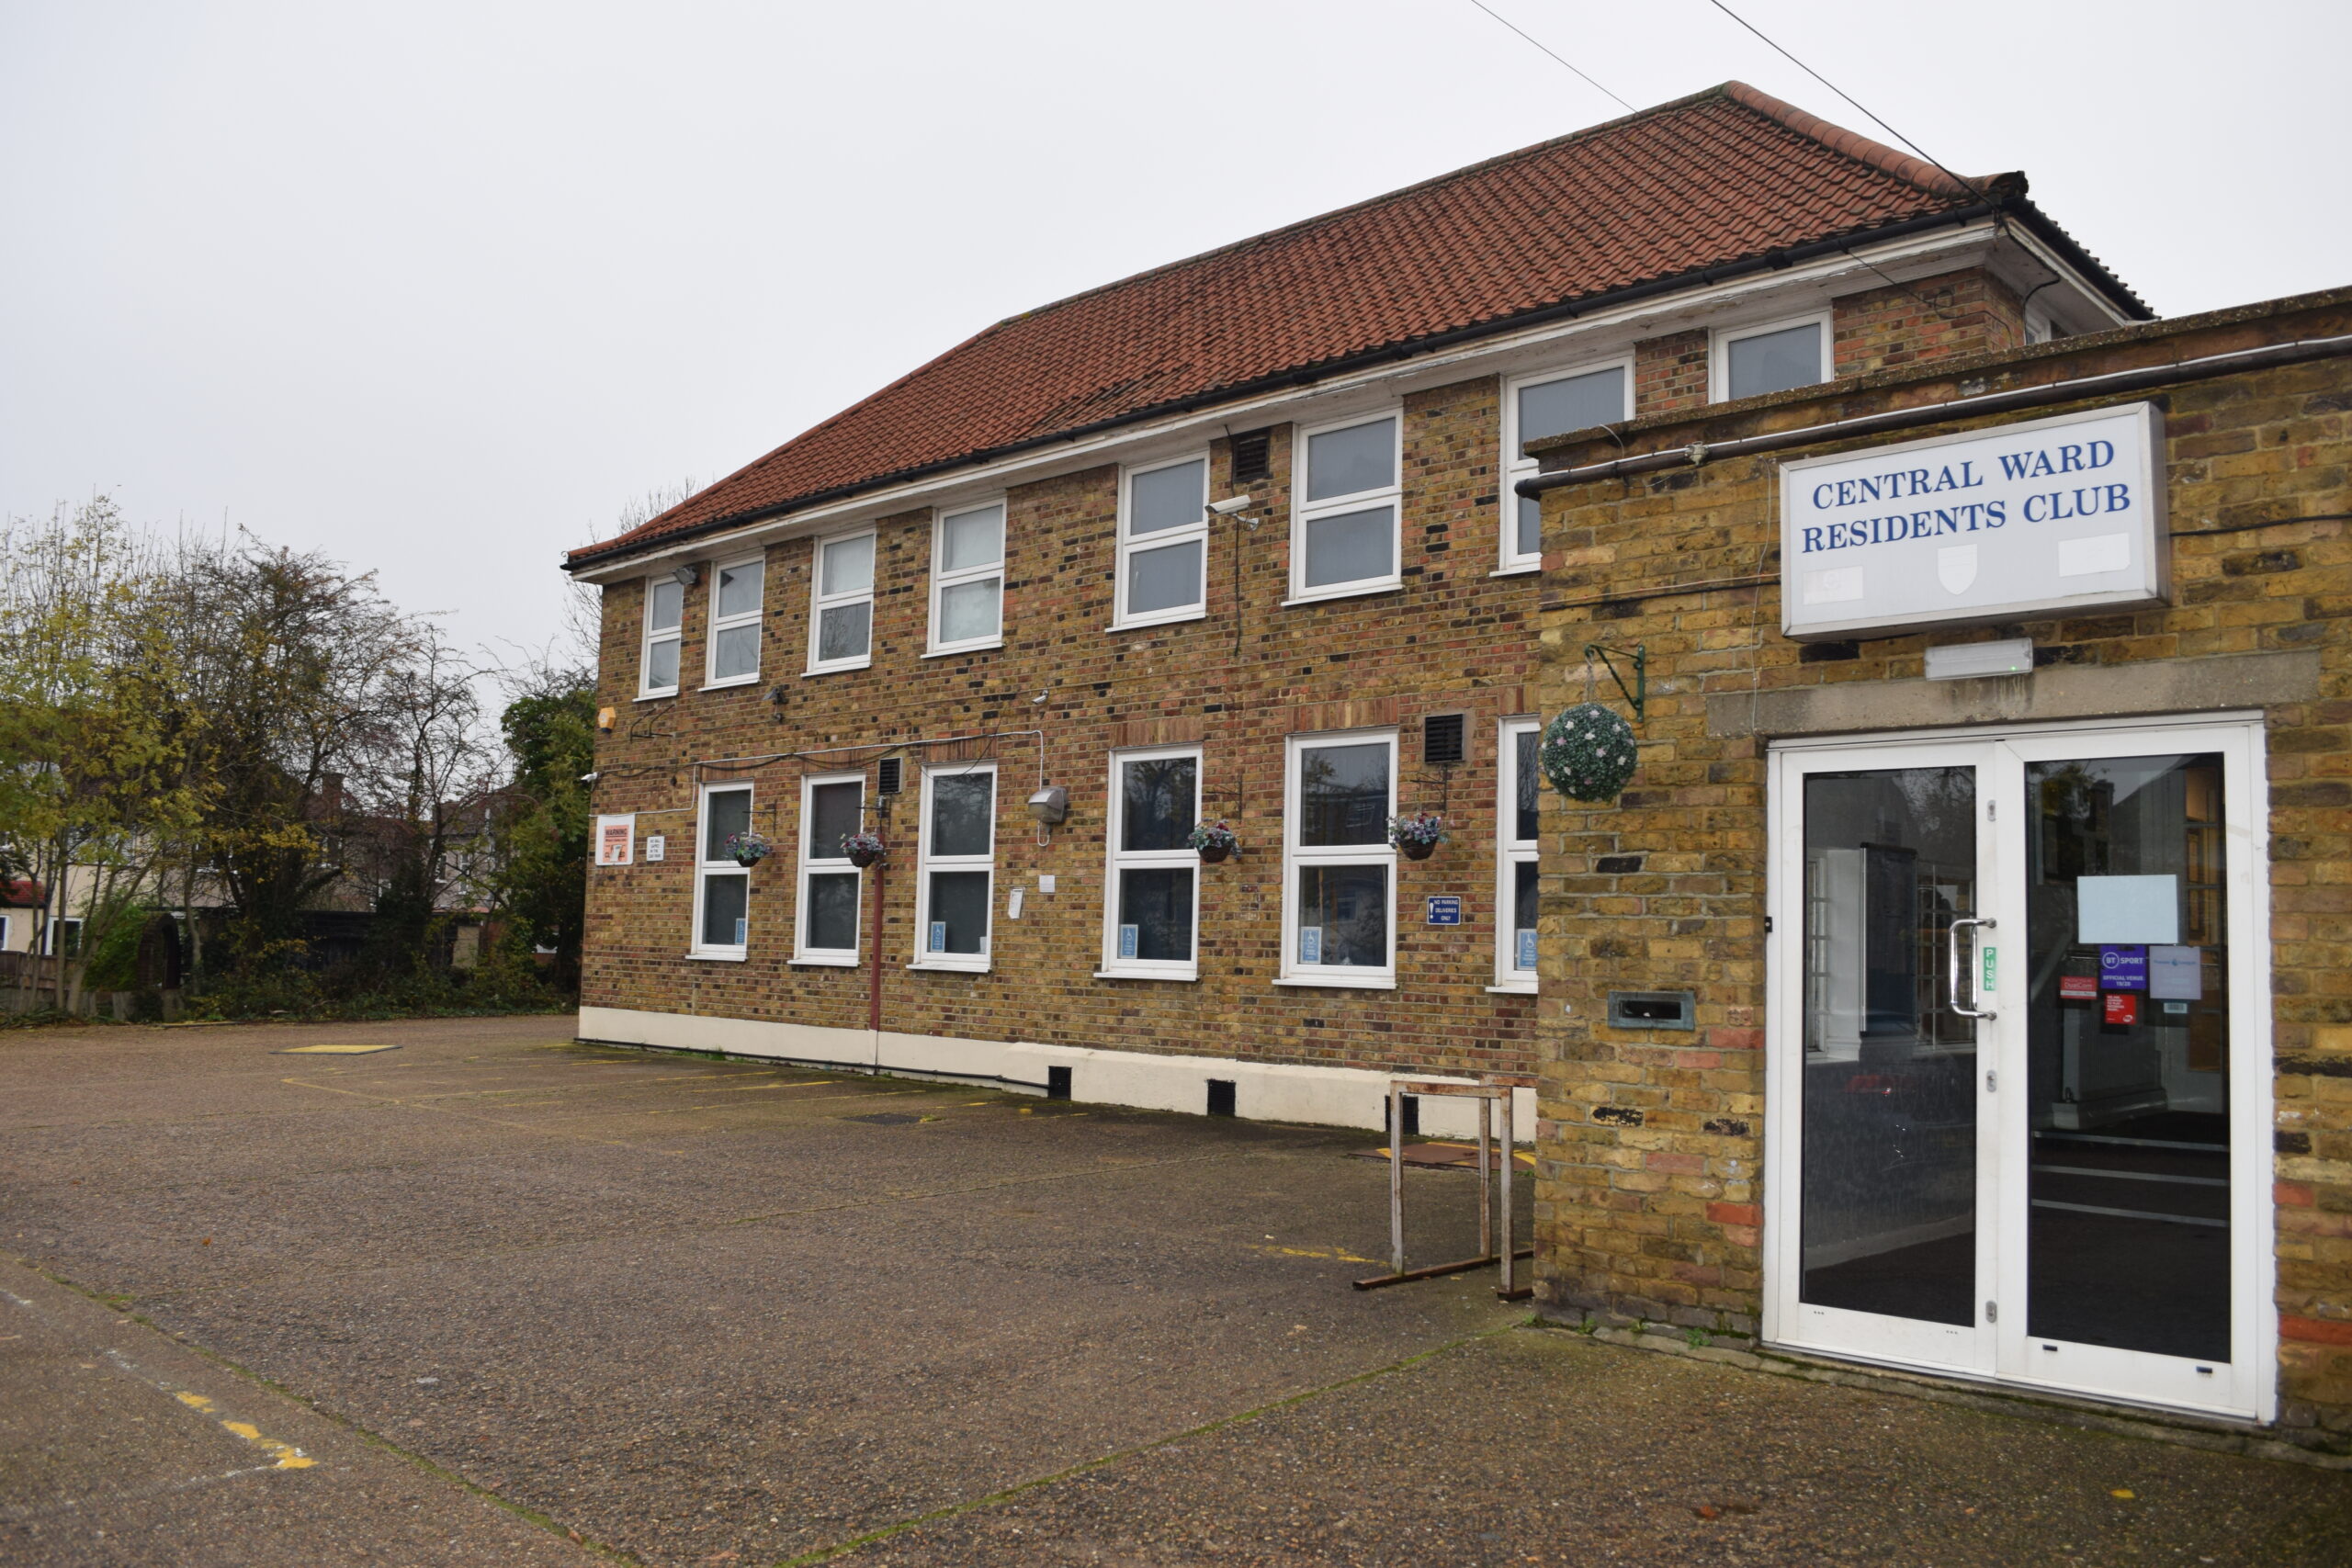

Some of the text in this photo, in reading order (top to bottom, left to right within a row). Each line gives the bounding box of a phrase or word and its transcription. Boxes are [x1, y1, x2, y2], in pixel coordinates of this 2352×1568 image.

[1813, 440, 2115, 510] CENTRAL WARD
[1802, 483, 2131, 553] RESIDENTS CLUB
[1985, 949, 1994, 989] PUSH
